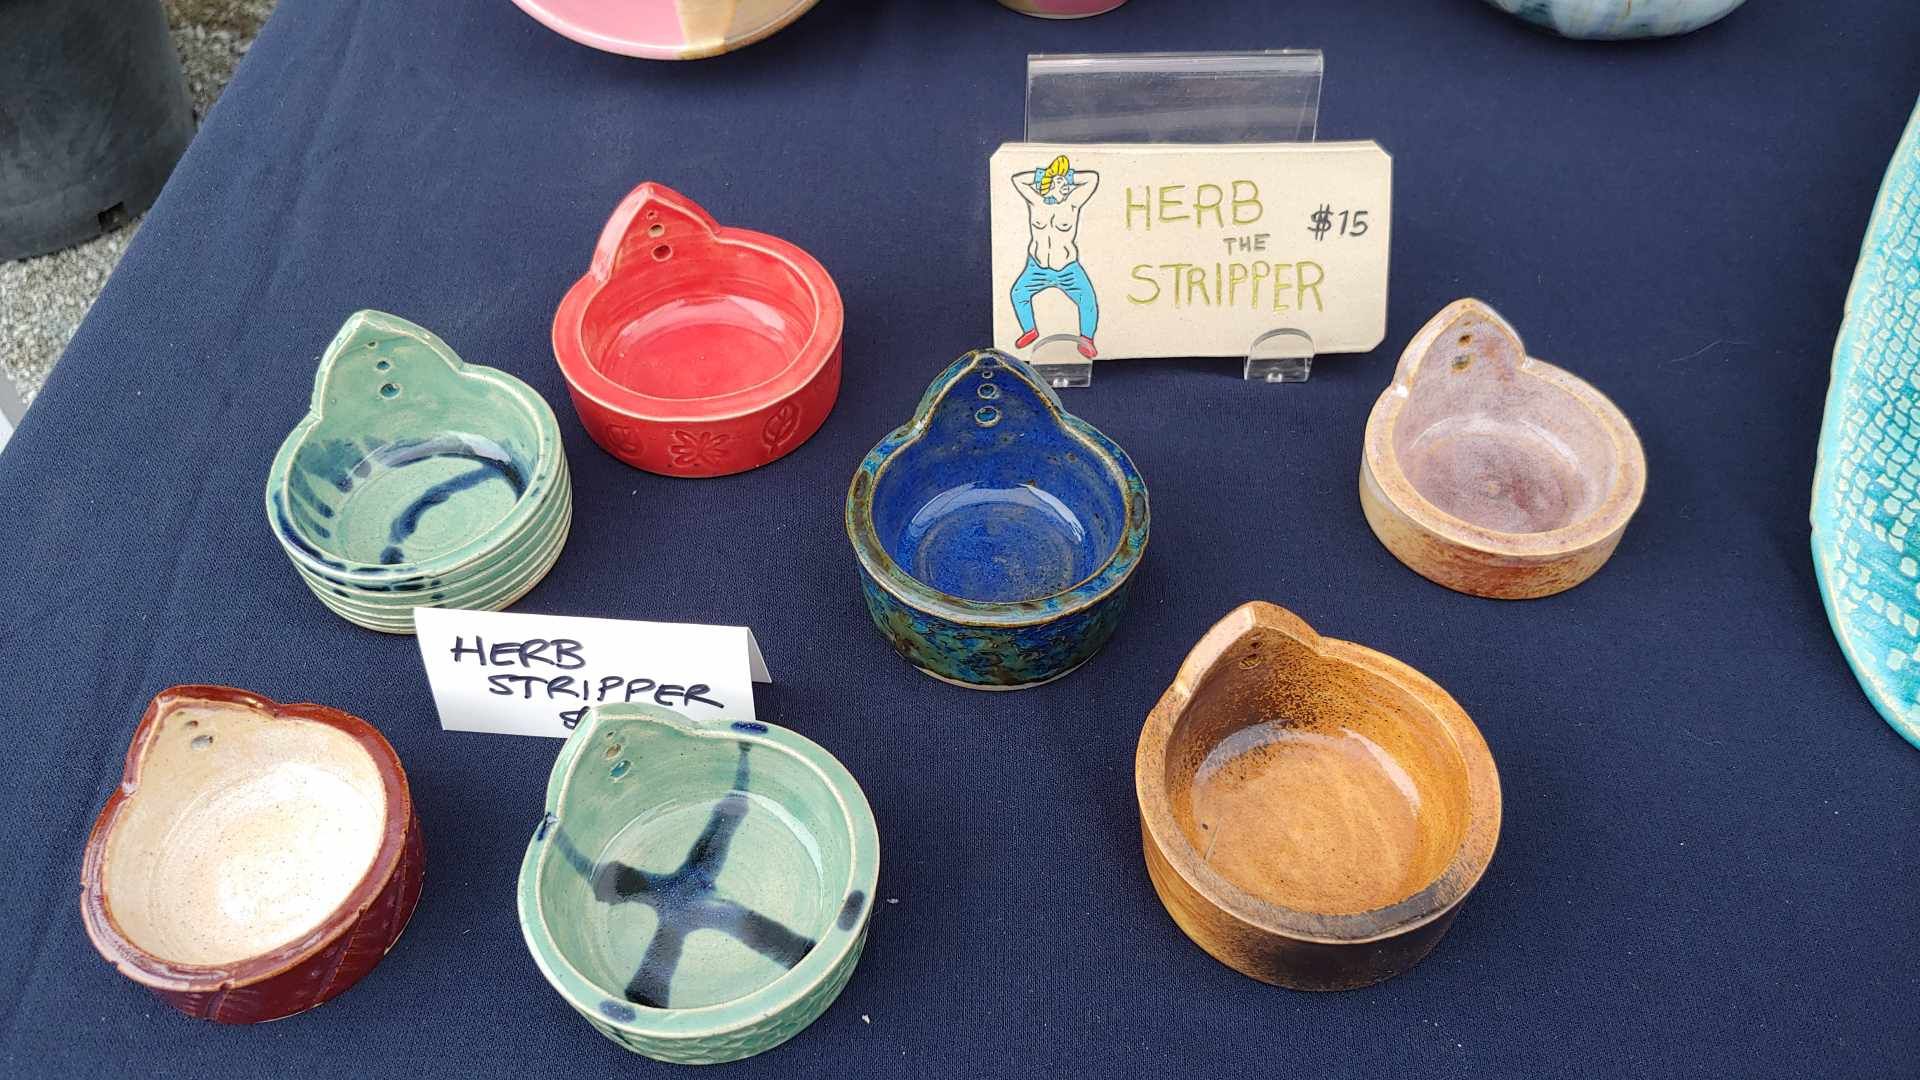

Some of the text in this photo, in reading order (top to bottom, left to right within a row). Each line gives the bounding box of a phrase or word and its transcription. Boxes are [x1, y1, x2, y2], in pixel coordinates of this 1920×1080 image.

[1125, 180, 1264, 230] HERB
[1307, 204, 1369, 241] $15
[1223, 233, 1271, 257] THE
[1126, 260, 1325, 312] STRIPPER
[450, 635, 587, 669] HERB
[487, 674, 725, 709] STRIPPER
